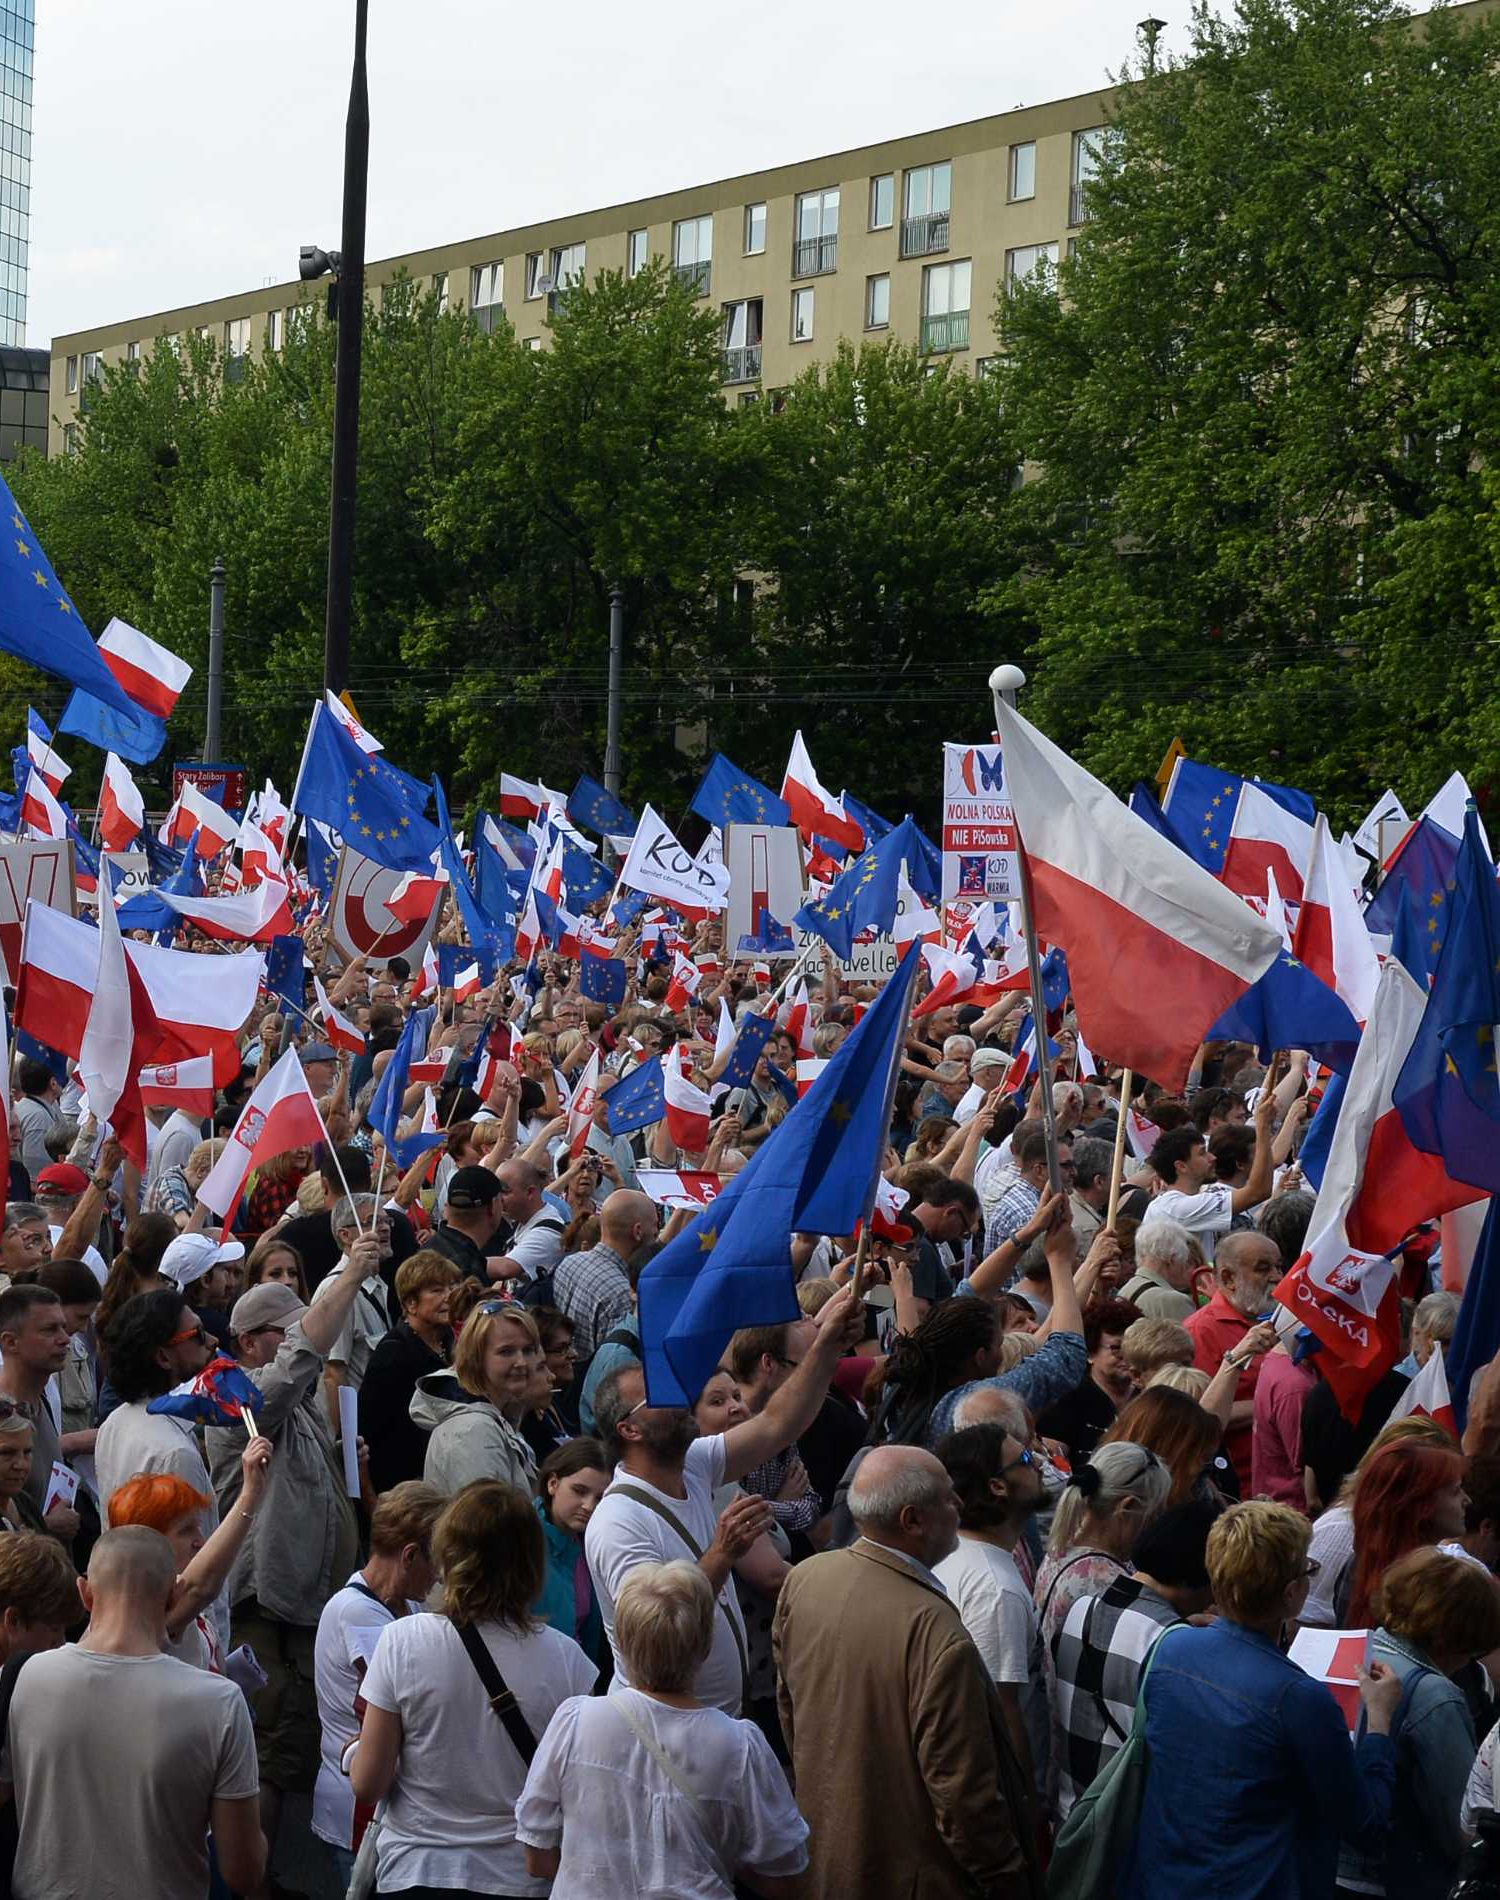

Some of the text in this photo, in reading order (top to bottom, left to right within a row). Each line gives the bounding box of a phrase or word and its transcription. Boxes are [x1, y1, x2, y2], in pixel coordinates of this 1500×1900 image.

[982, 805, 1012, 821] POLSKA
[952, 829, 1009, 845] NIE PiSowska
[644, 833, 716, 886] KOD
